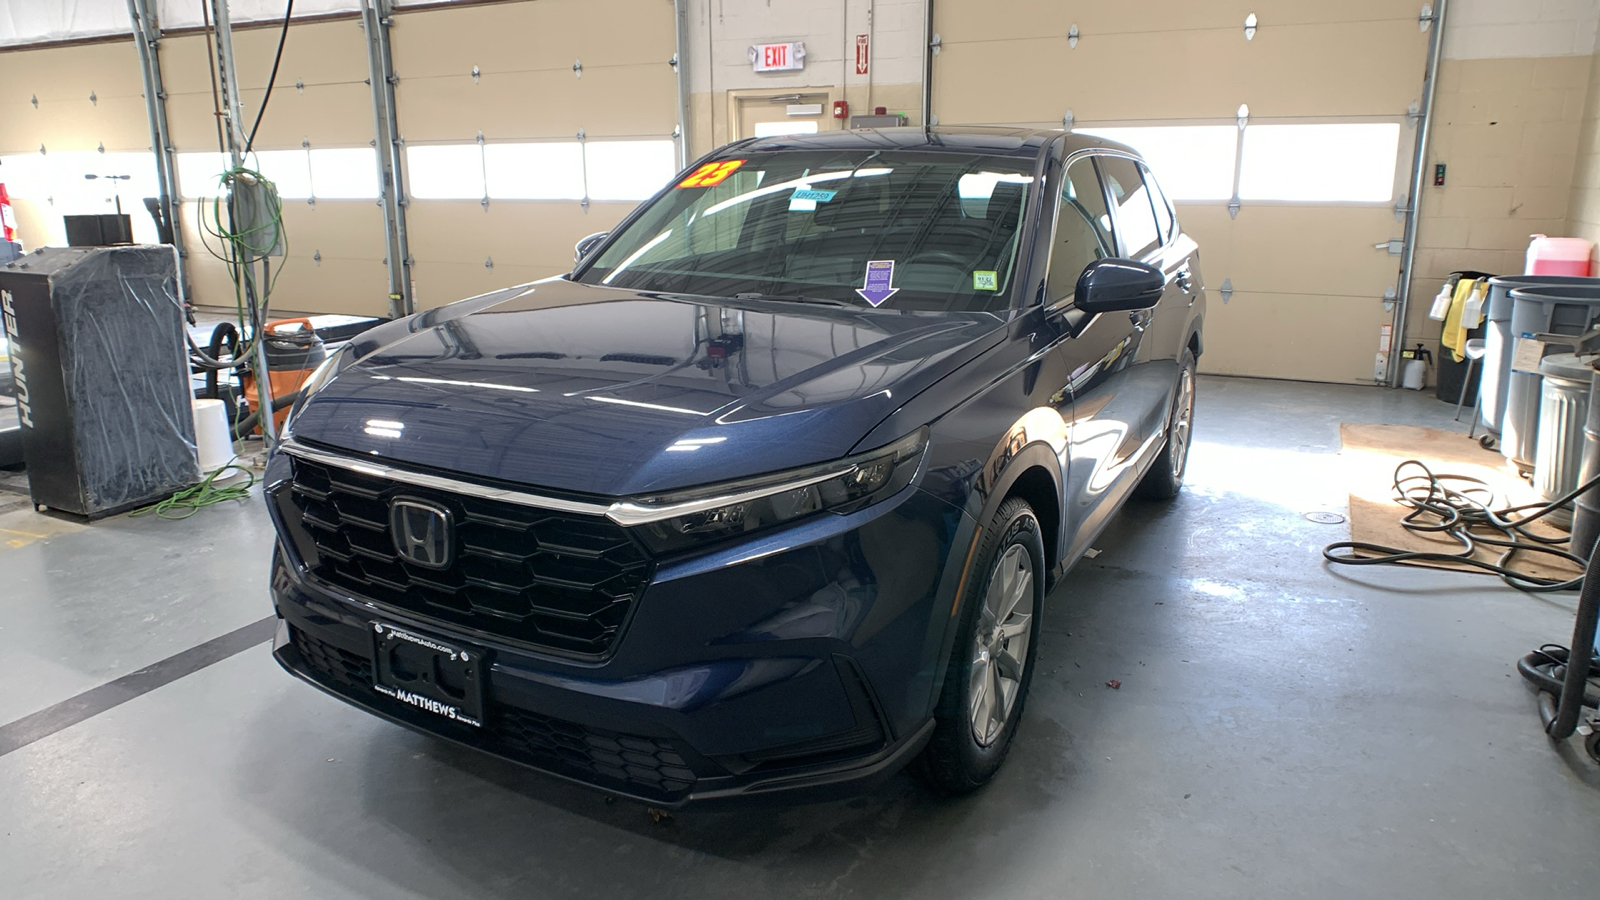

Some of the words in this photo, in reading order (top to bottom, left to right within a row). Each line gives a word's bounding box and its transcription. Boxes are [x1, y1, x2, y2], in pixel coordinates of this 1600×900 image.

[765, 46, 787, 67] EXIT
[679, 160, 742, 187] 23
[1, 289, 34, 429] HUNTER
[396, 689, 456, 719] MATTHEWS
